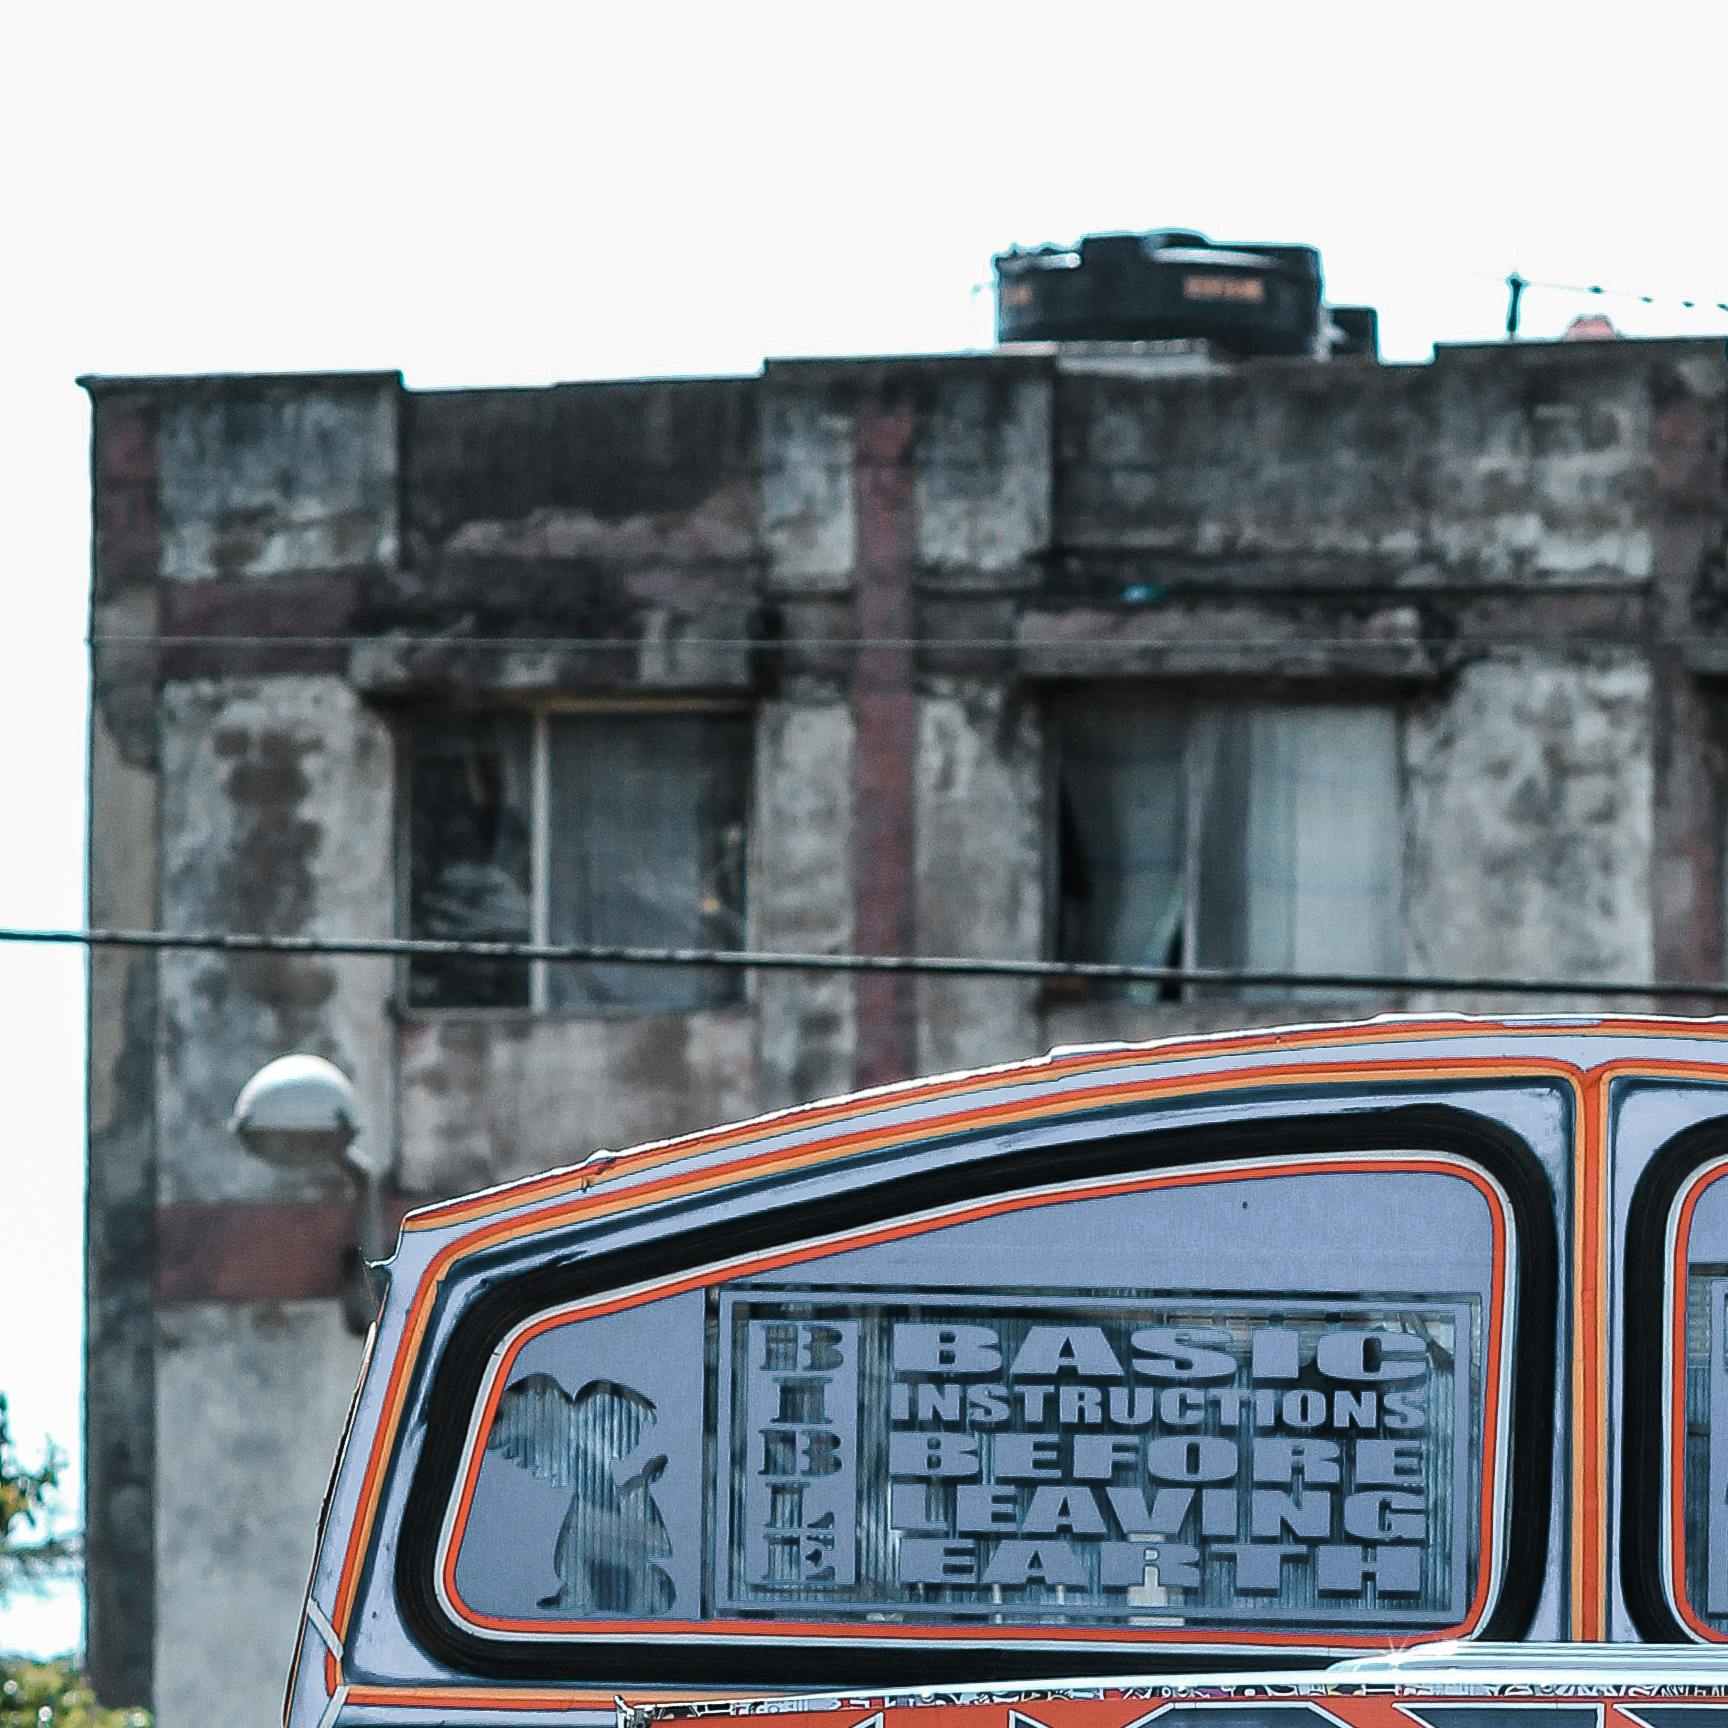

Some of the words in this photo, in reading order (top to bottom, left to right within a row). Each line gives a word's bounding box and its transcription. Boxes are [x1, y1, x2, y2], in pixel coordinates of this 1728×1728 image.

[894, 1322, 1428, 1381] BASIC
[892, 1385, 1425, 1429] INSTRUCTIONS
[761, 1322, 842, 1583] BIBLE
[892, 1433, 1425, 1484] BEFORE
[892, 1488, 1427, 1538] LEAVING
[900, 1541, 1424, 1592] EARTH
